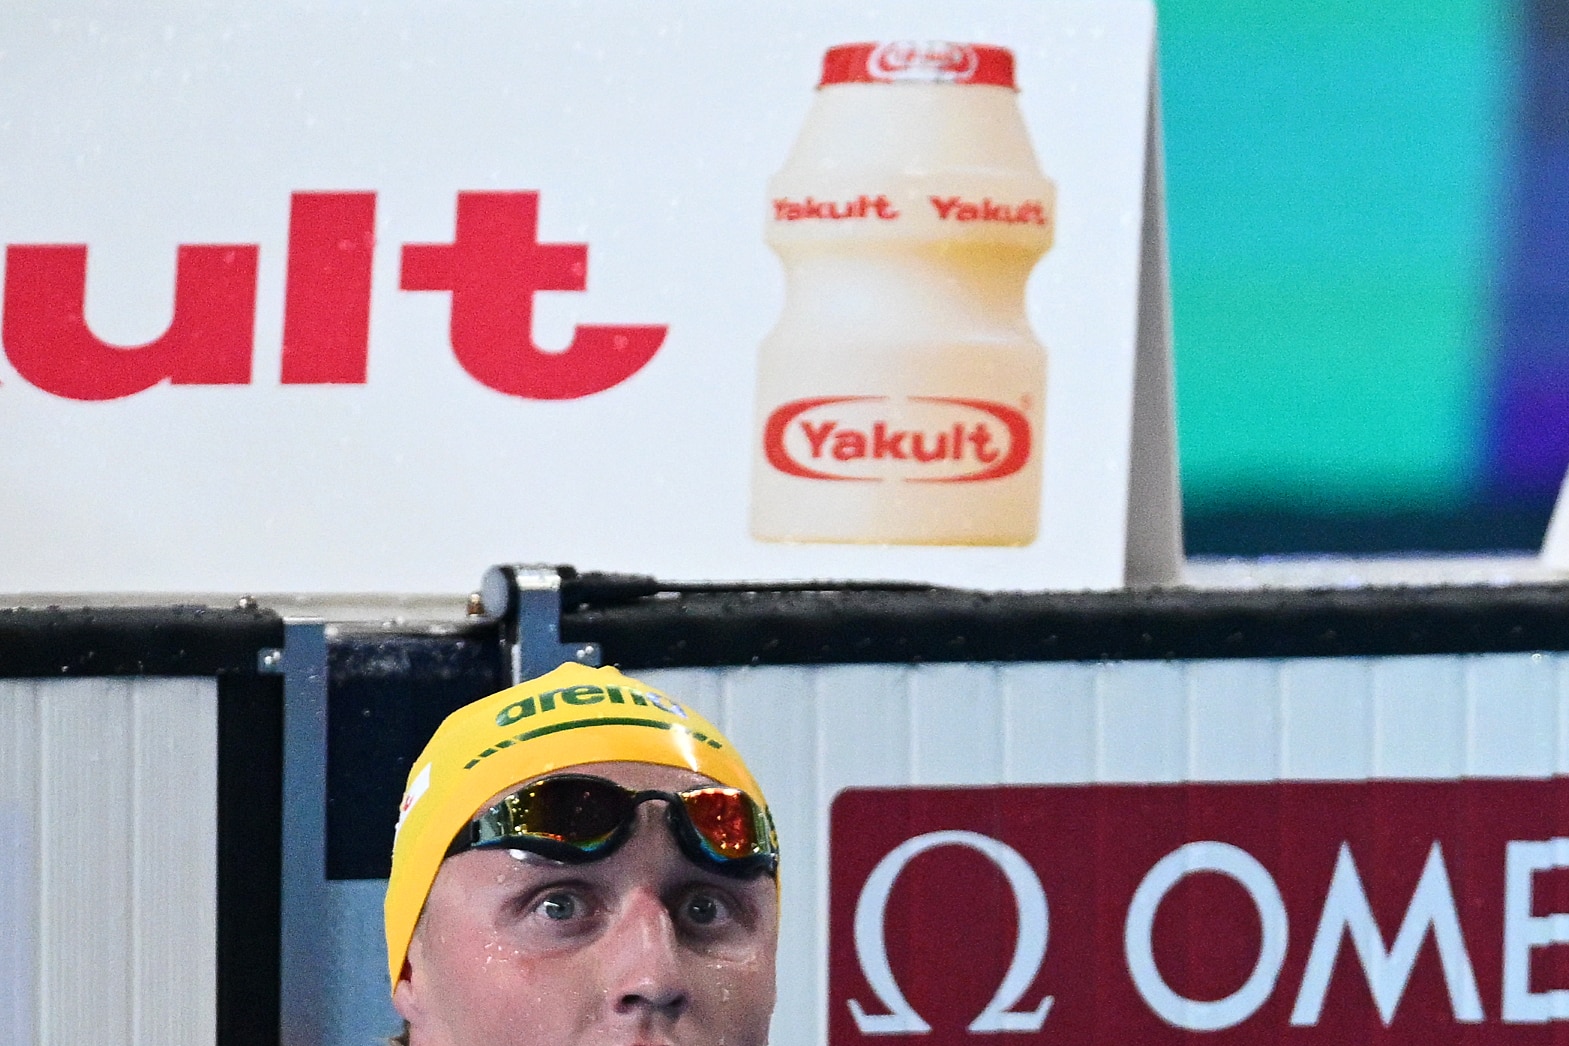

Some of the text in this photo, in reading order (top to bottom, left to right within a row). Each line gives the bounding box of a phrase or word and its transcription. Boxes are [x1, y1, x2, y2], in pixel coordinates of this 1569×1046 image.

[772, 194, 1048, 226] Yakult Yakult
[0, 189, 669, 401] ult
[801, 421, 999, 463] Yakult
[495, 684, 688, 727] arena
